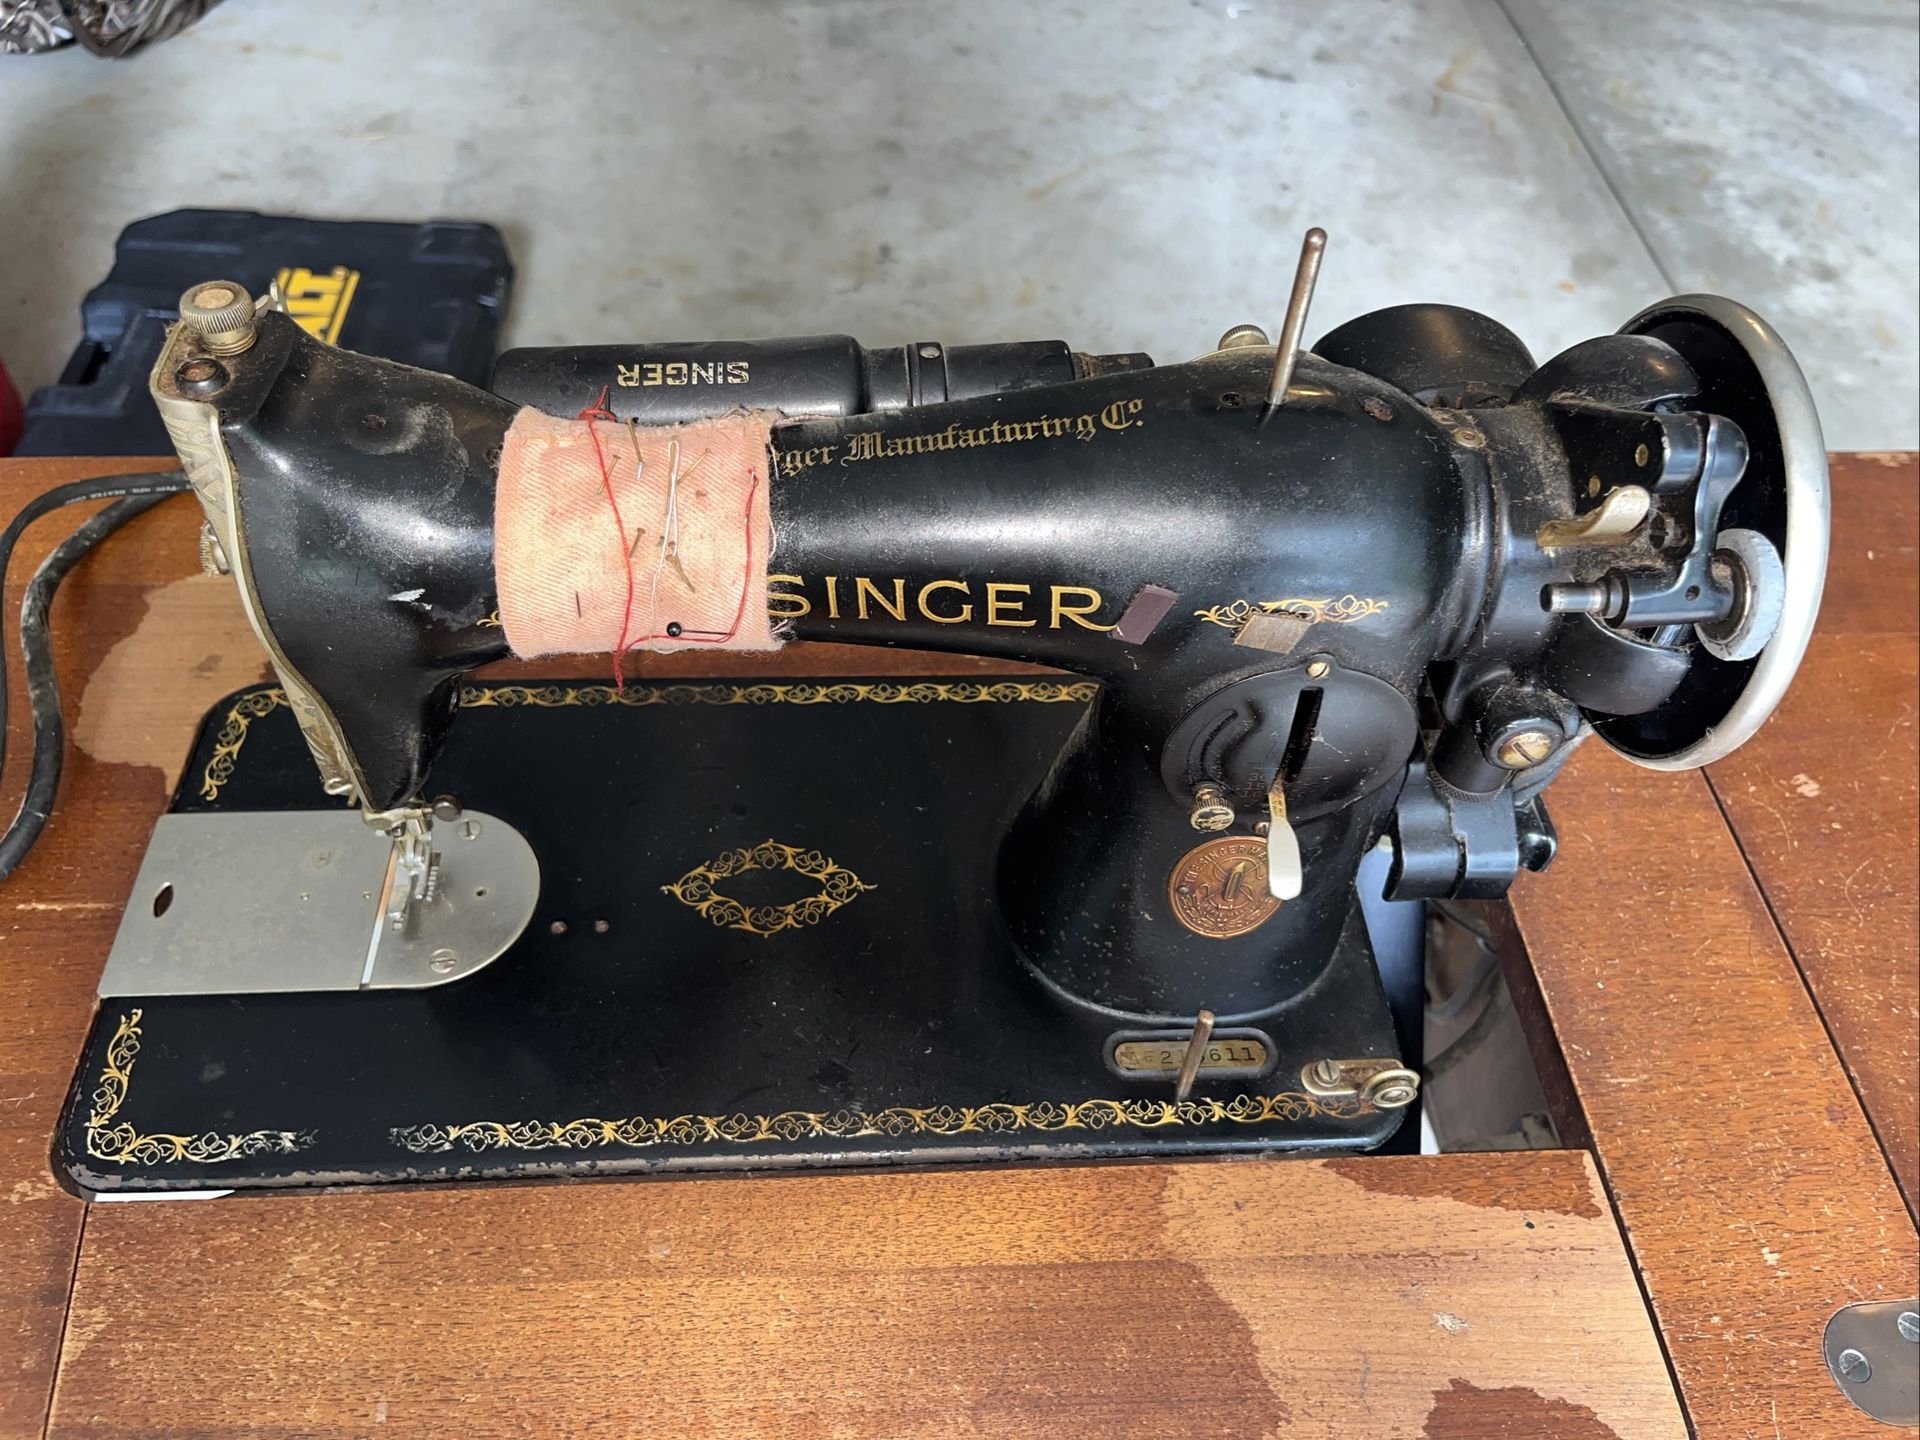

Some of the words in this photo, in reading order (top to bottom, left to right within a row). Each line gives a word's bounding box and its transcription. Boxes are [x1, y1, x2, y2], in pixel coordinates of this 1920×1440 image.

[617, 361, 749, 387] SINGER
[841, 414, 1098, 468] Manufacturing
[767, 574, 1119, 633] SINGER
[1199, 844, 1246, 867] SINGER
